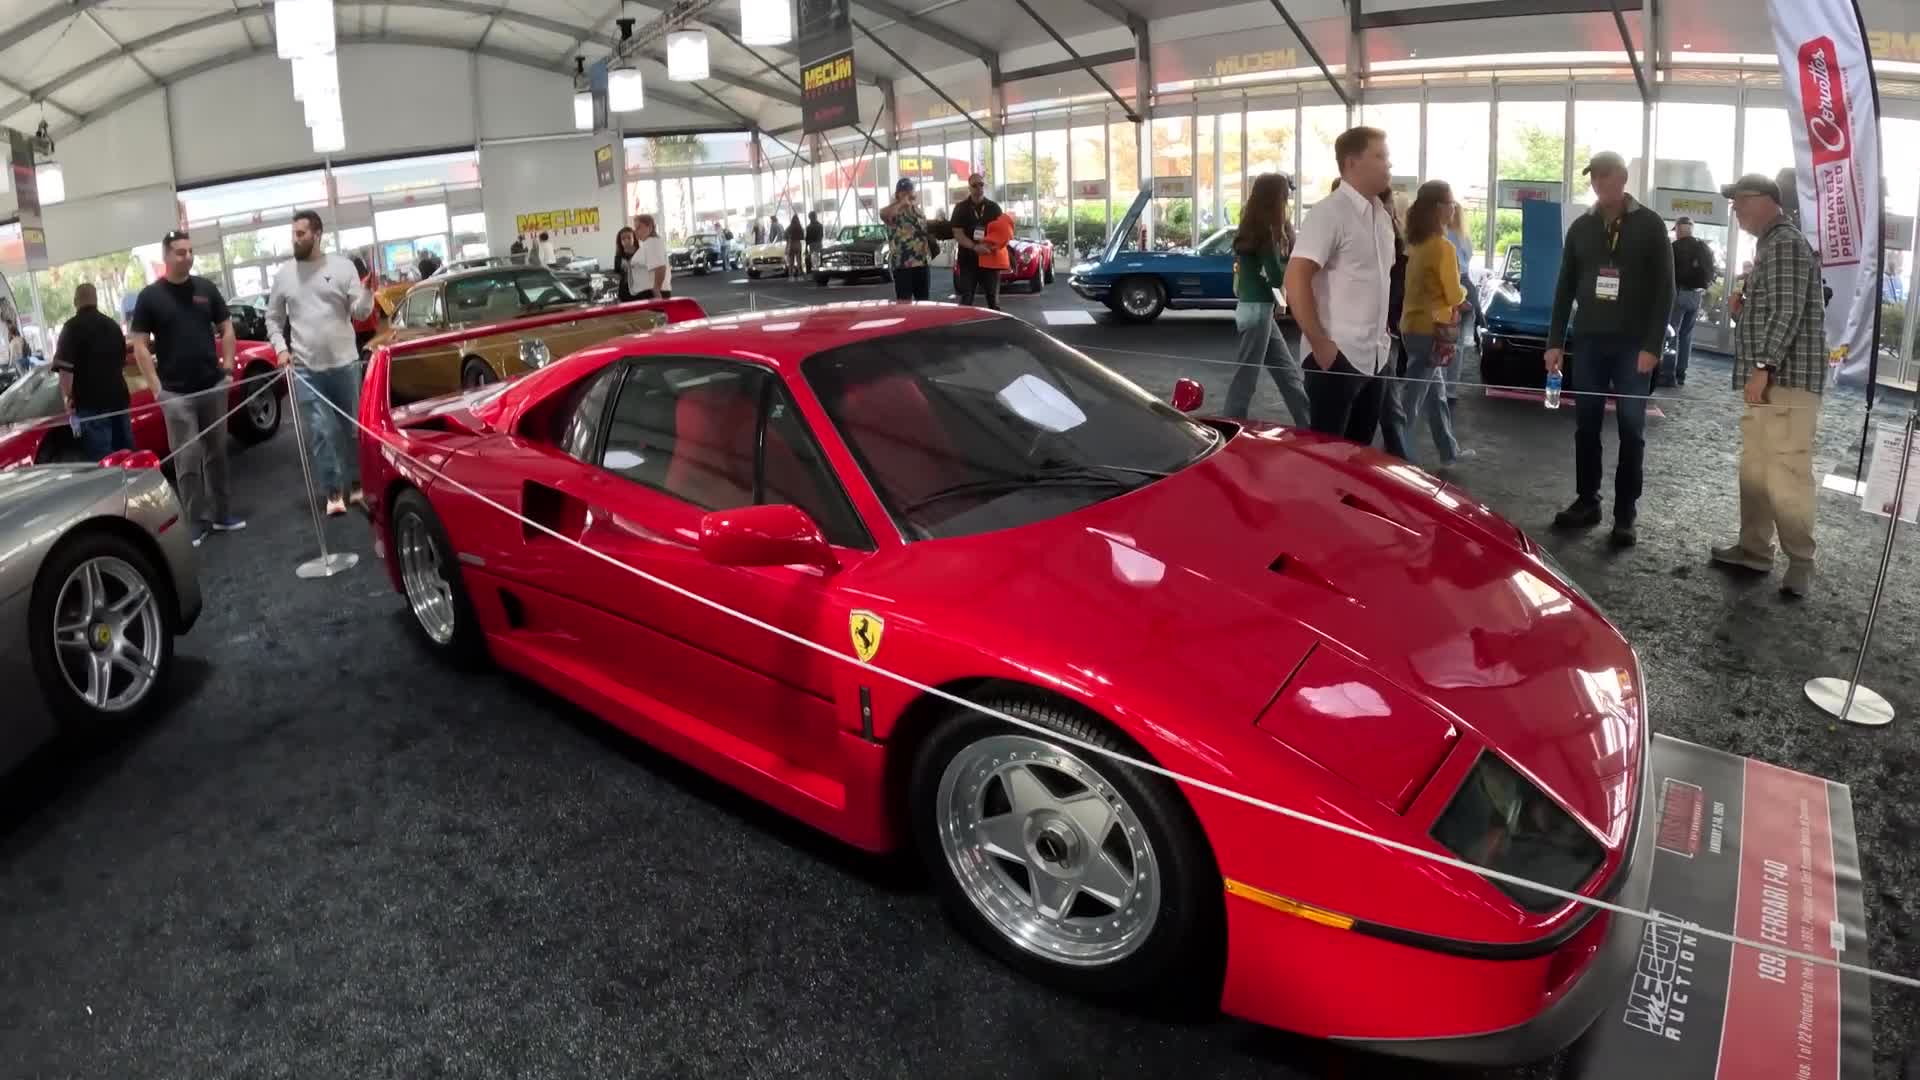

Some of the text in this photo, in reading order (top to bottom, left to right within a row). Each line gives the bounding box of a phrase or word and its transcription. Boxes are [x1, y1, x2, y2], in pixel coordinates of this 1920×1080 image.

[804, 56, 852, 91] MECUM
[516, 207, 600, 234] MECUM
[1824, 168, 1840, 258] ULTIMATELY
[1834, 165, 1852, 257] PRESERVED
[1758, 859, 1789, 984] 199 FERRARI F40
[1623, 907, 1683, 1035] MECUM
[1800, 992, 1813, 1031] Produced
[1797, 1031, 1812, 1043] 22
[1797, 1043, 1812, 1054] of
